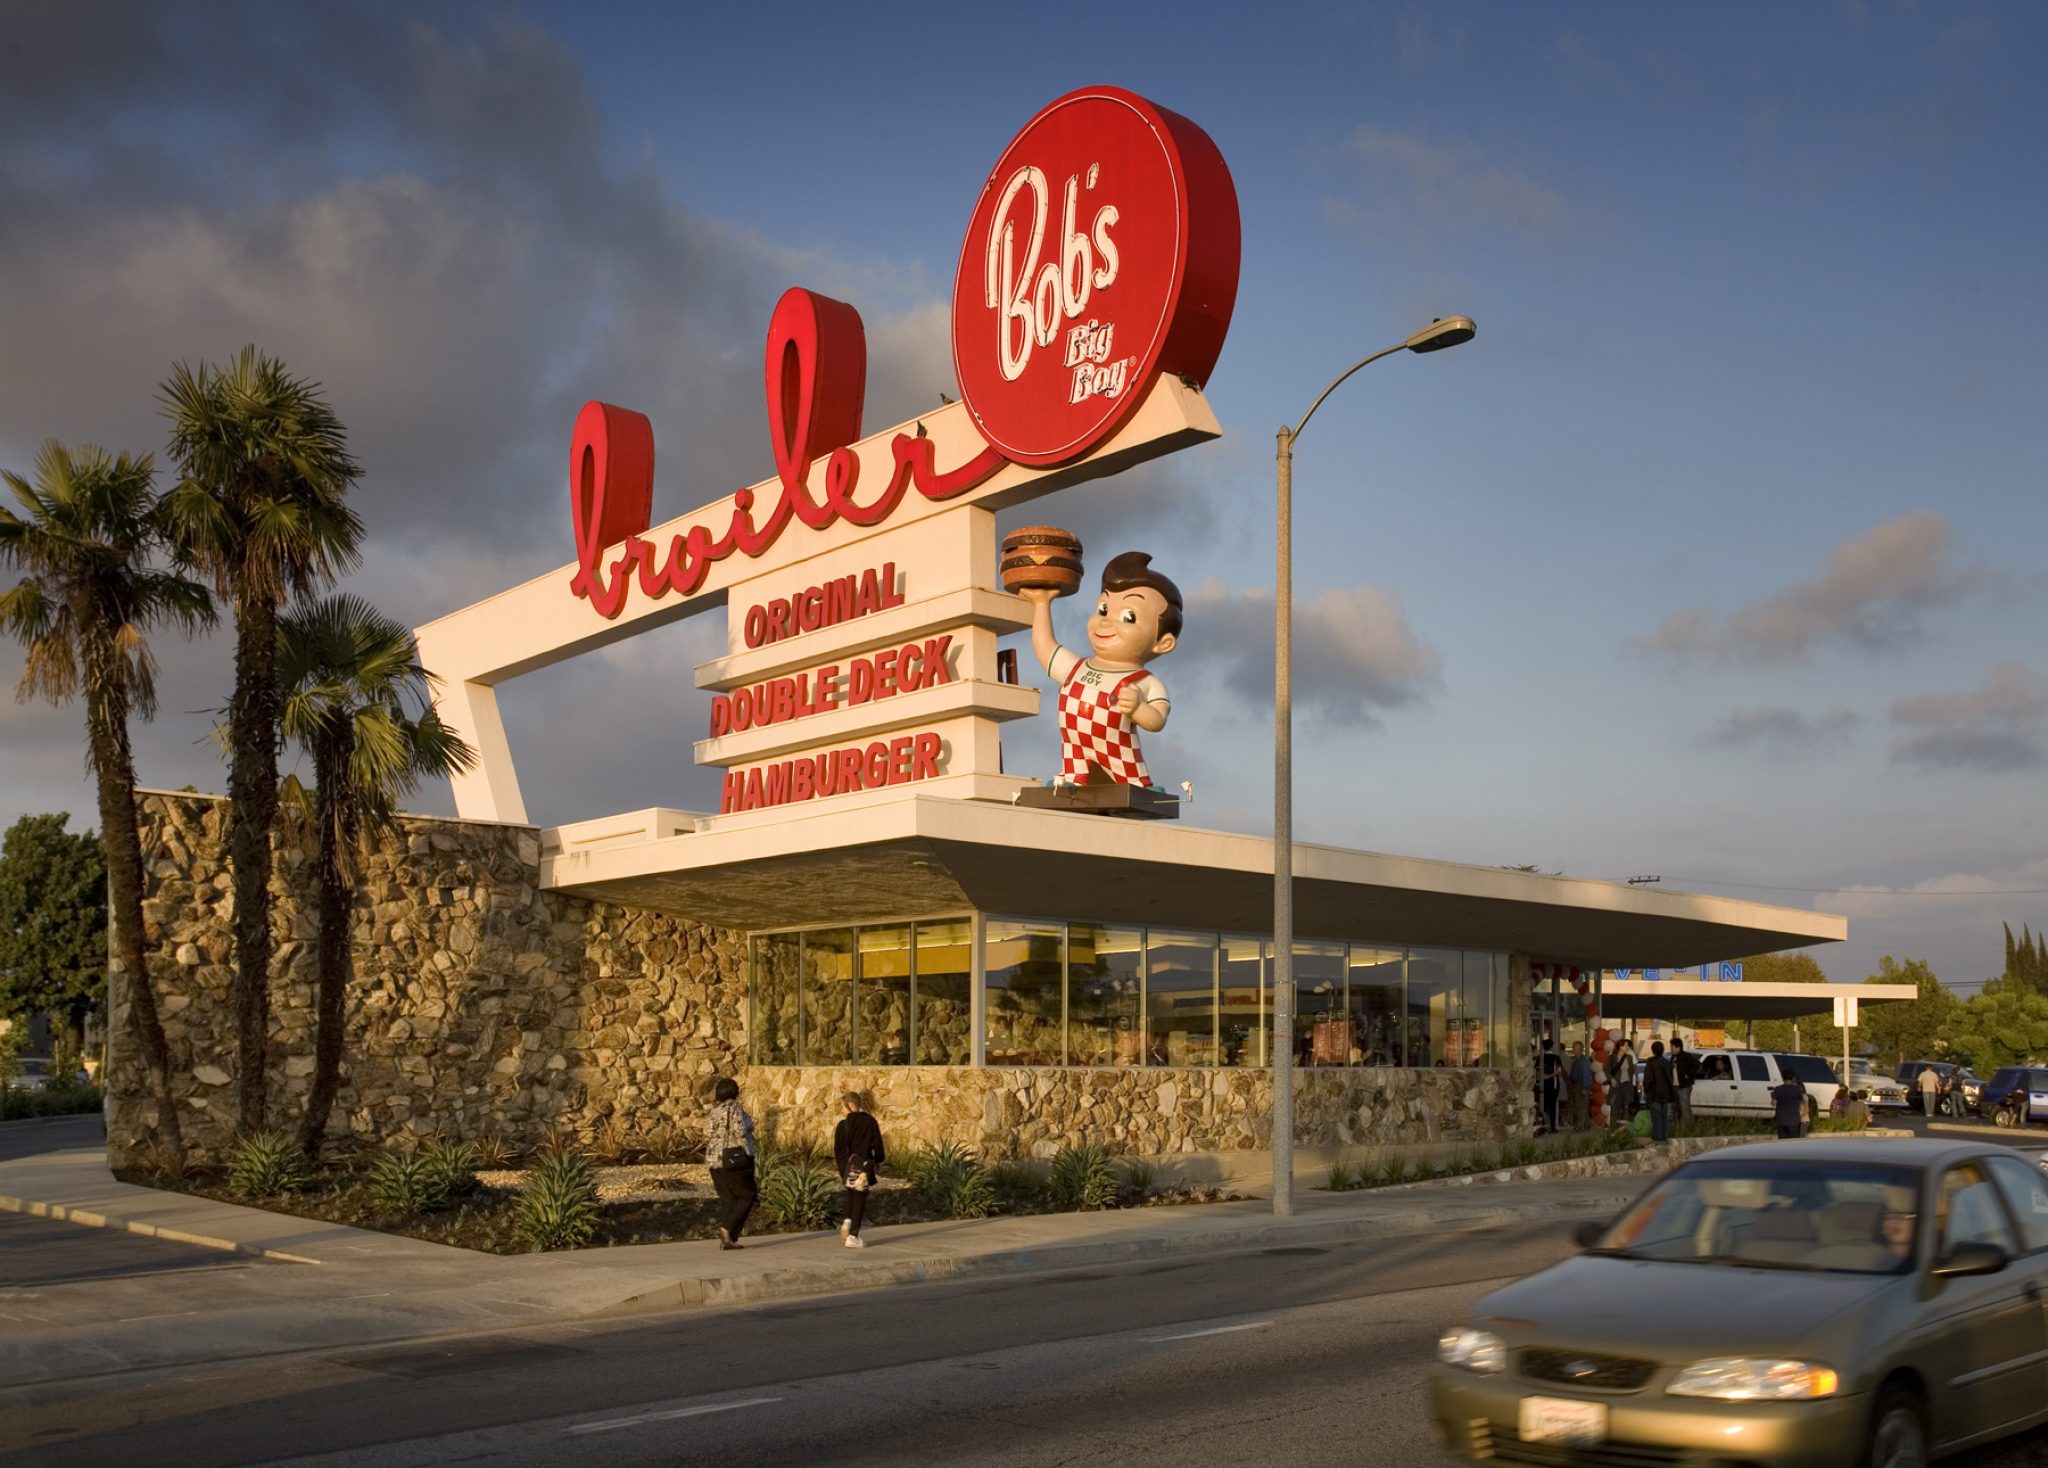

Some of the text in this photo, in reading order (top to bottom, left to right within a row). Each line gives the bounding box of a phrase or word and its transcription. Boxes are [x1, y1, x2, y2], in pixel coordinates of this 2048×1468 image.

[985, 162, 1120, 382] Bob's
[1063, 318, 1115, 368] Big
[1068, 359, 1128, 405] Boy
[569, 286, 1011, 619] broiler
[744, 561, 905, 649] ORIGINAL
[709, 635, 953, 738] DOUBLE DECK
[1080, 675, 1102, 687] BOY
[1086, 670, 1104, 680] BIG
[720, 732, 942, 814] HAMBURGER
